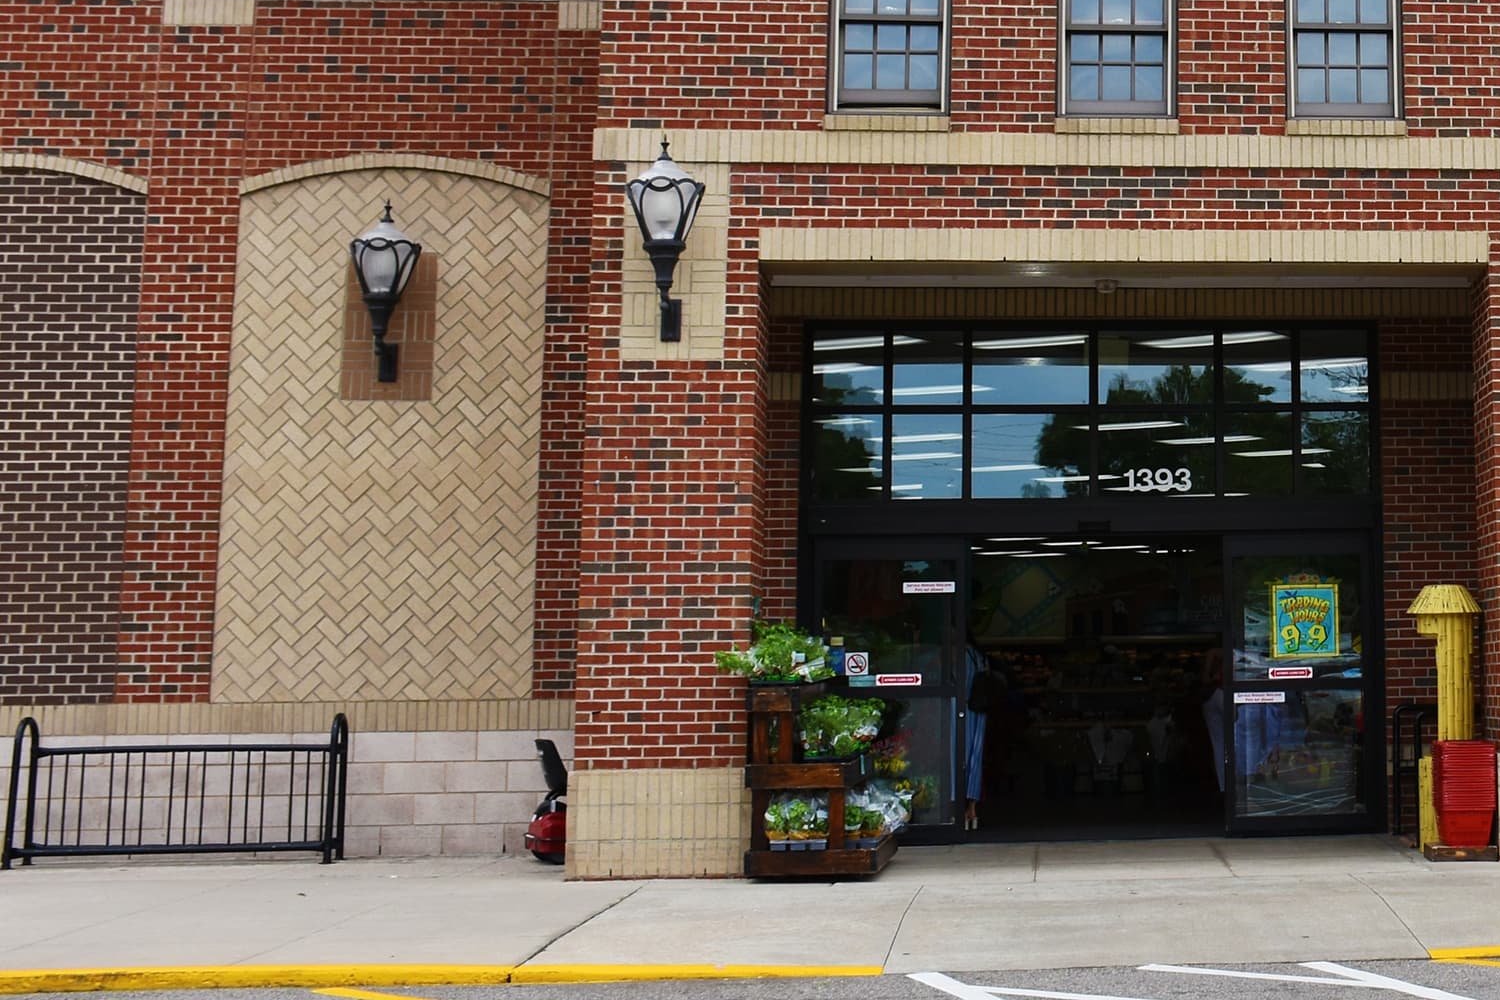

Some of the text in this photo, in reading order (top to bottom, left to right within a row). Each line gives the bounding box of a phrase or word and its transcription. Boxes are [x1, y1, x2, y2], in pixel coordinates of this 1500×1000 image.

[1123, 468, 1192, 492] 1393
[1280, 596, 1330, 613] TRADING
[1288, 609, 1327, 624] HOURS
